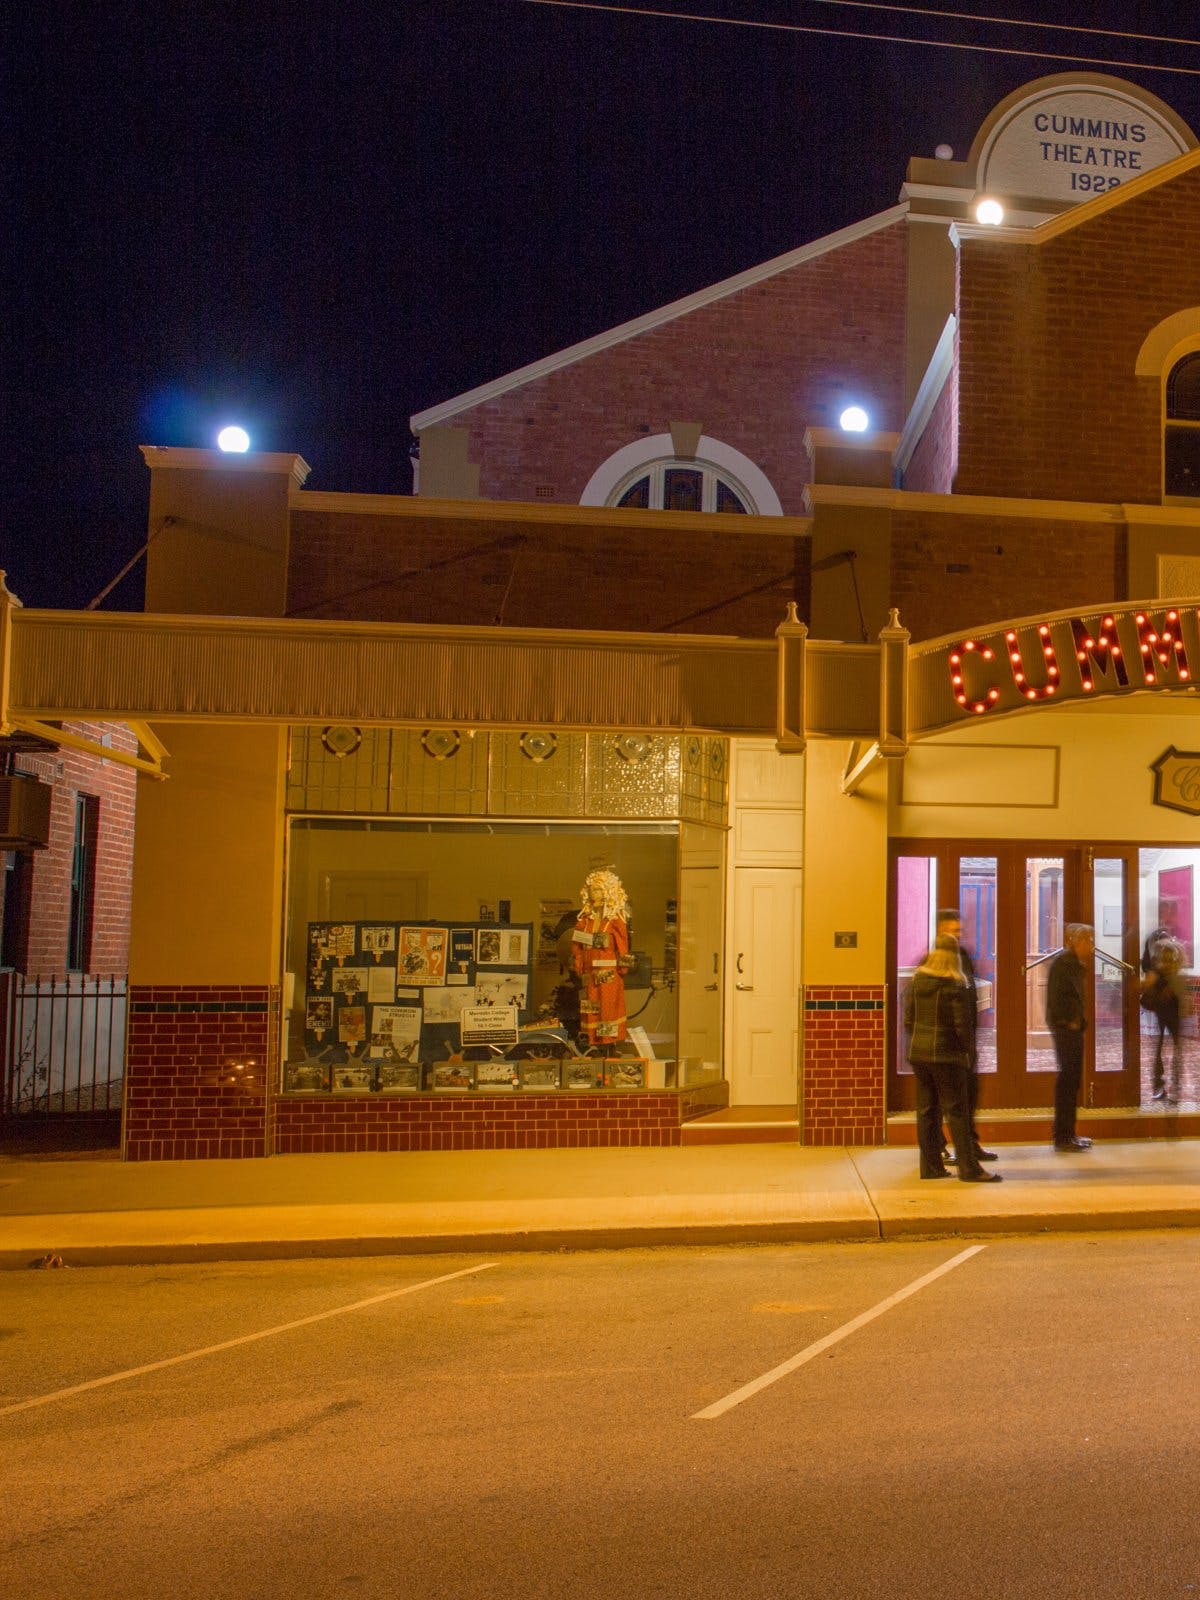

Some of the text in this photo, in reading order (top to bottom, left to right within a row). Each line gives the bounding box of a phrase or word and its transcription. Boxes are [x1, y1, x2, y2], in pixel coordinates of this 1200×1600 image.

[1034, 113, 1147, 143] CUMMINS
[1040, 141, 1142, 170] THEATRE
[1071, 172, 1121, 193] 1928
